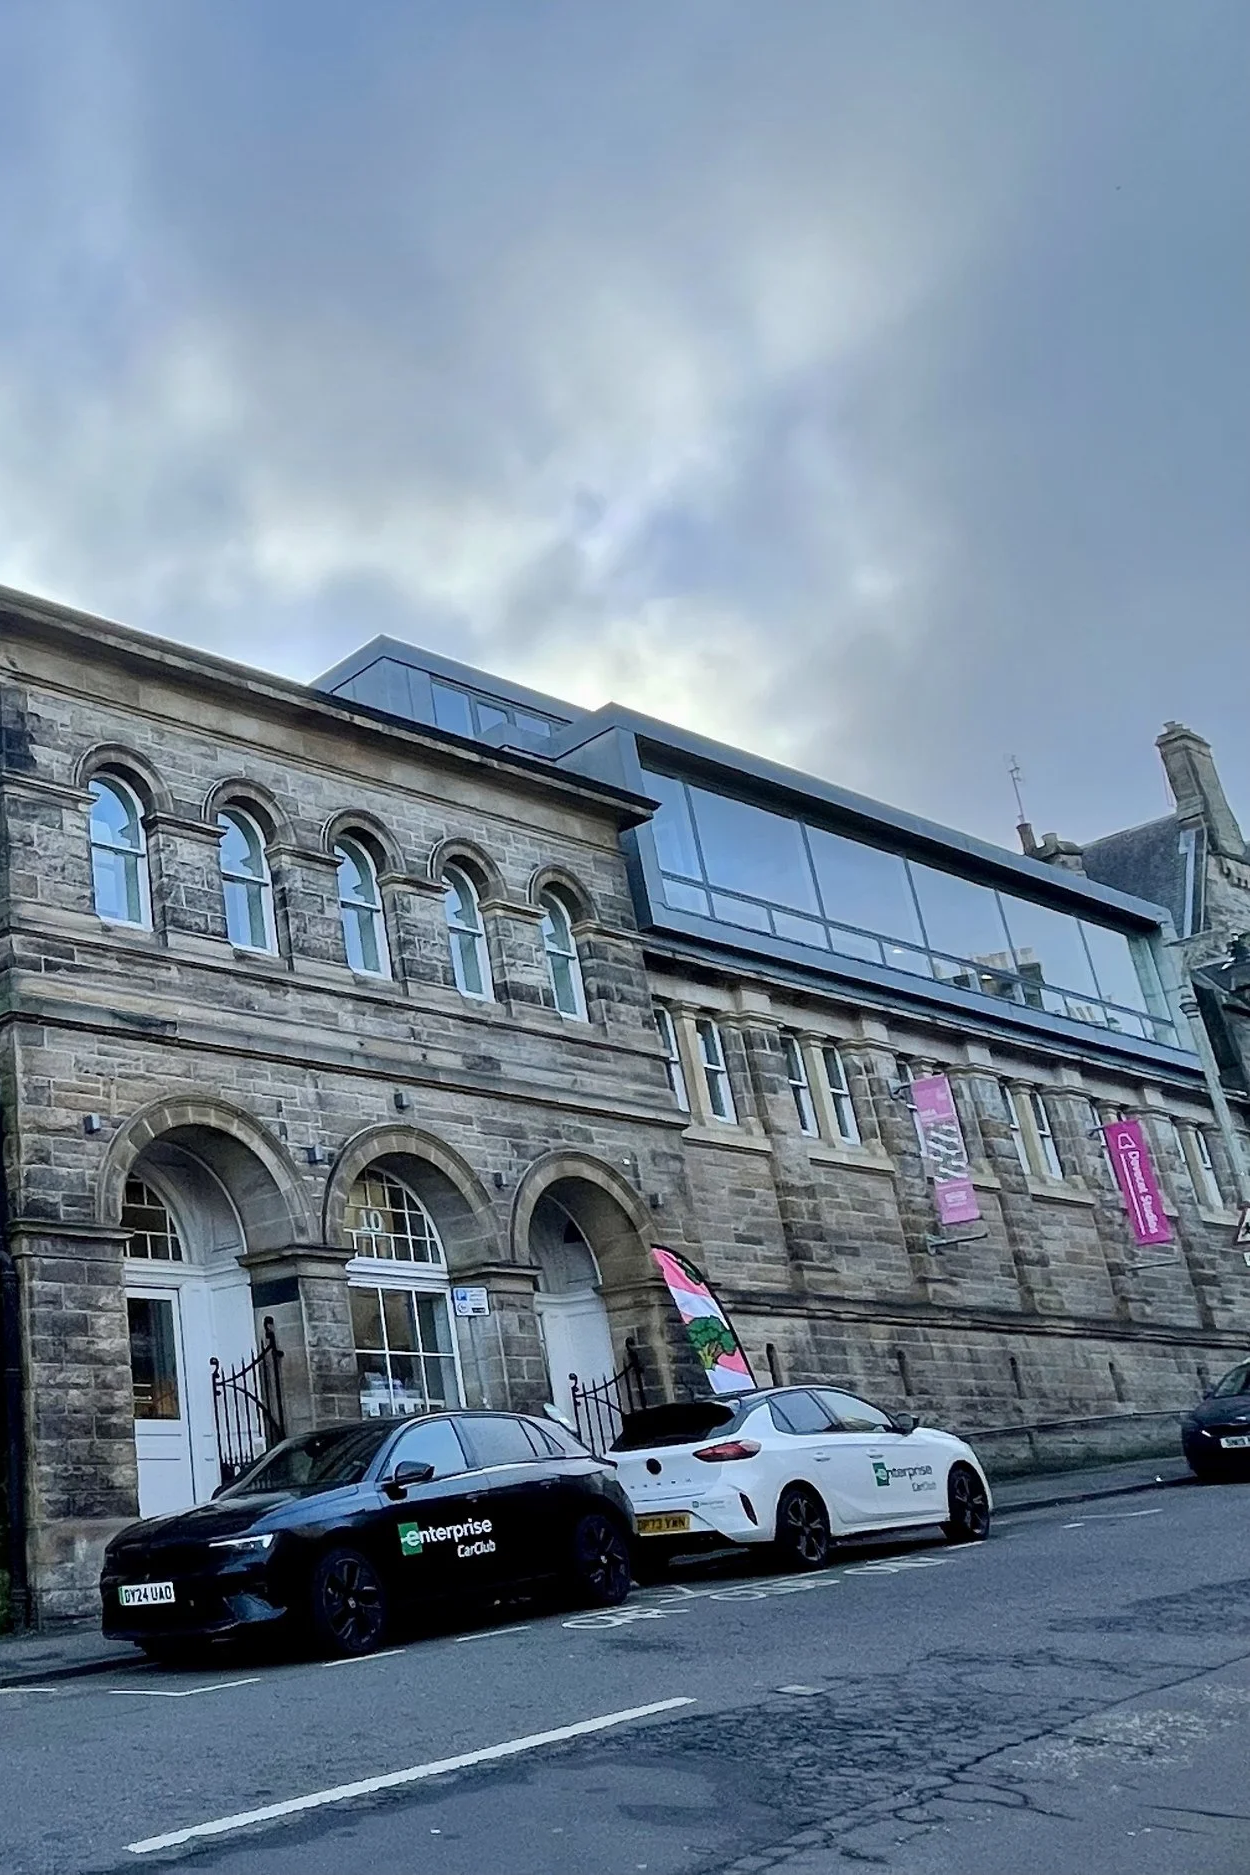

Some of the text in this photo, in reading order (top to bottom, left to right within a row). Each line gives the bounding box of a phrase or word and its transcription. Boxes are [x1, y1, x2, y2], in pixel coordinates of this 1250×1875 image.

[359, 1209, 382, 1231] 10
[401, 1518, 492, 1547] enterprise
[457, 1539, 496, 1557] CarClub
